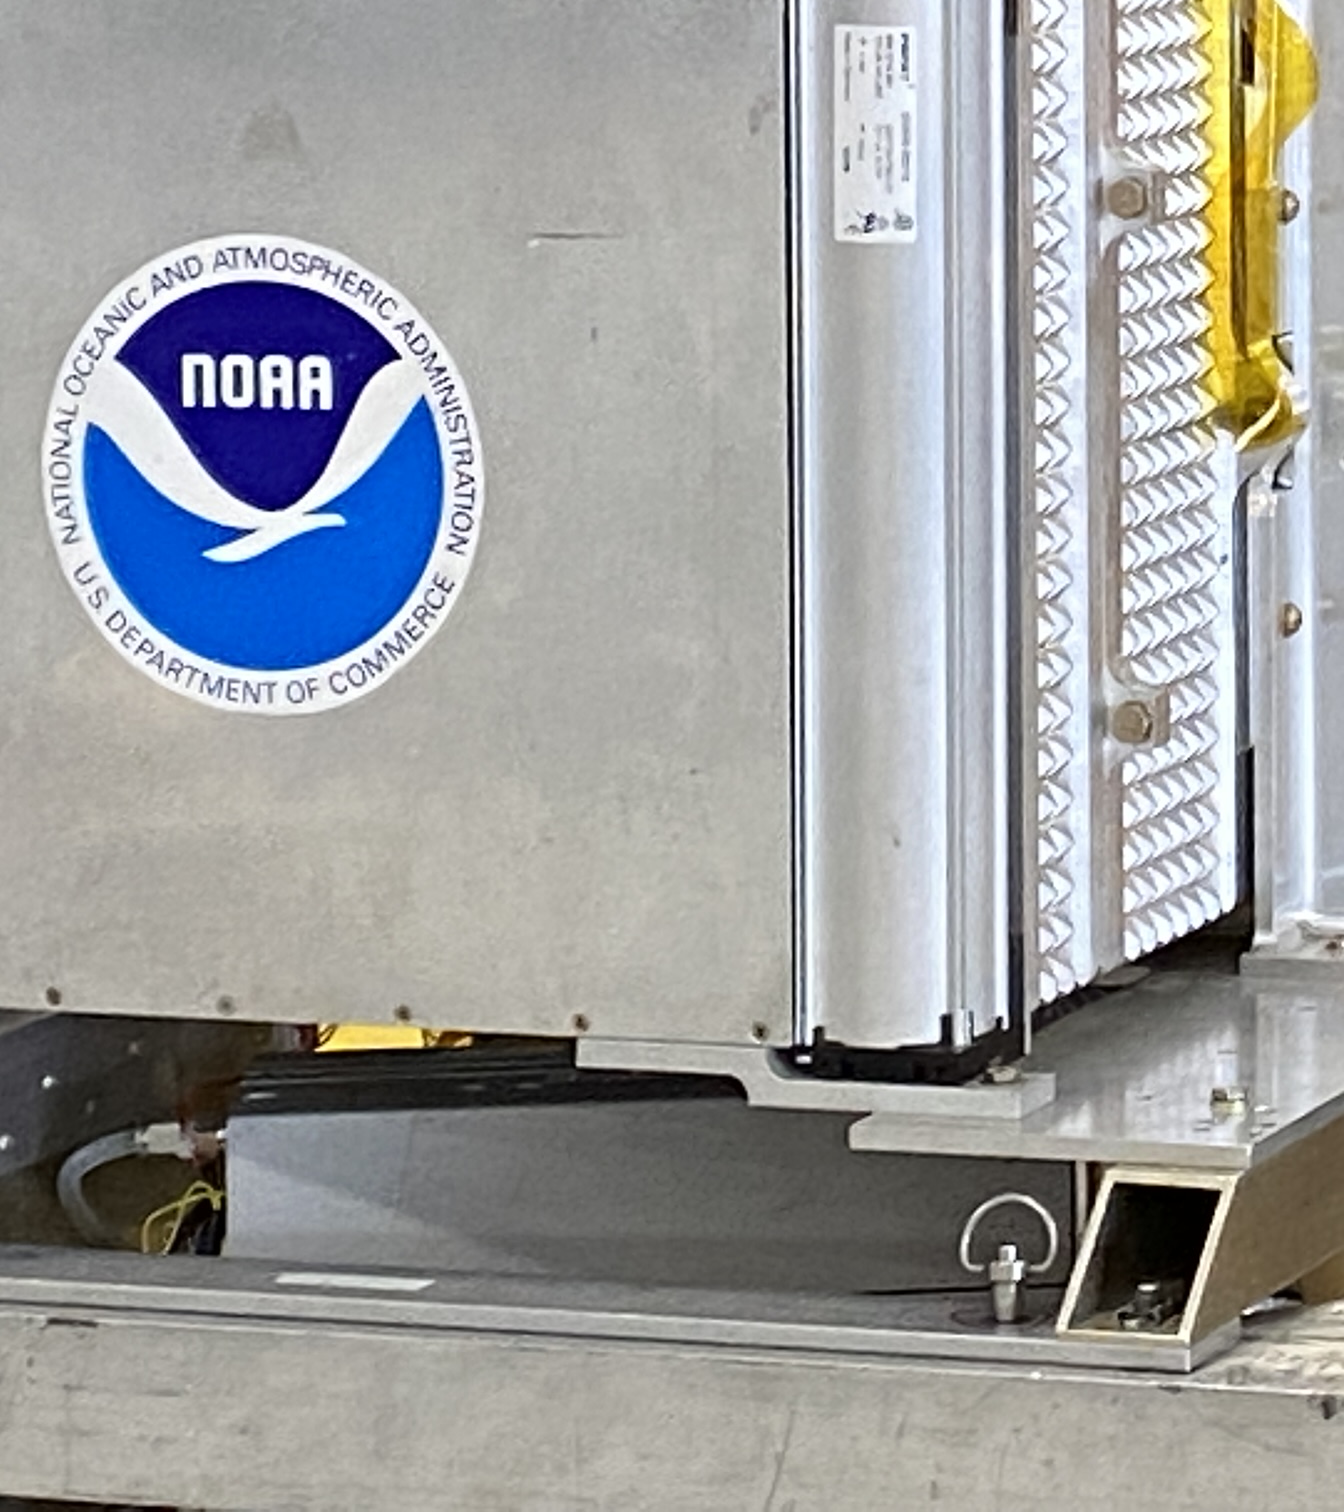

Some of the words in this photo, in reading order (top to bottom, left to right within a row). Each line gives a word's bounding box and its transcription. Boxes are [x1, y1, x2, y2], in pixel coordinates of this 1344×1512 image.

[150, 254, 204, 298] AND
[213, 246, 398, 321] ATMOSPHERIC
[63, 286, 147, 396] OCEANIC
[181, 353, 334, 411] NOAA
[49, 403, 82, 546] NATIONAL
[393, 319, 475, 556] ADMINISTRATION
[104, 609, 278, 705] DEPARTMENT
[286, 678, 320, 704] OF
[328, 571, 456, 695] COMMERCE
